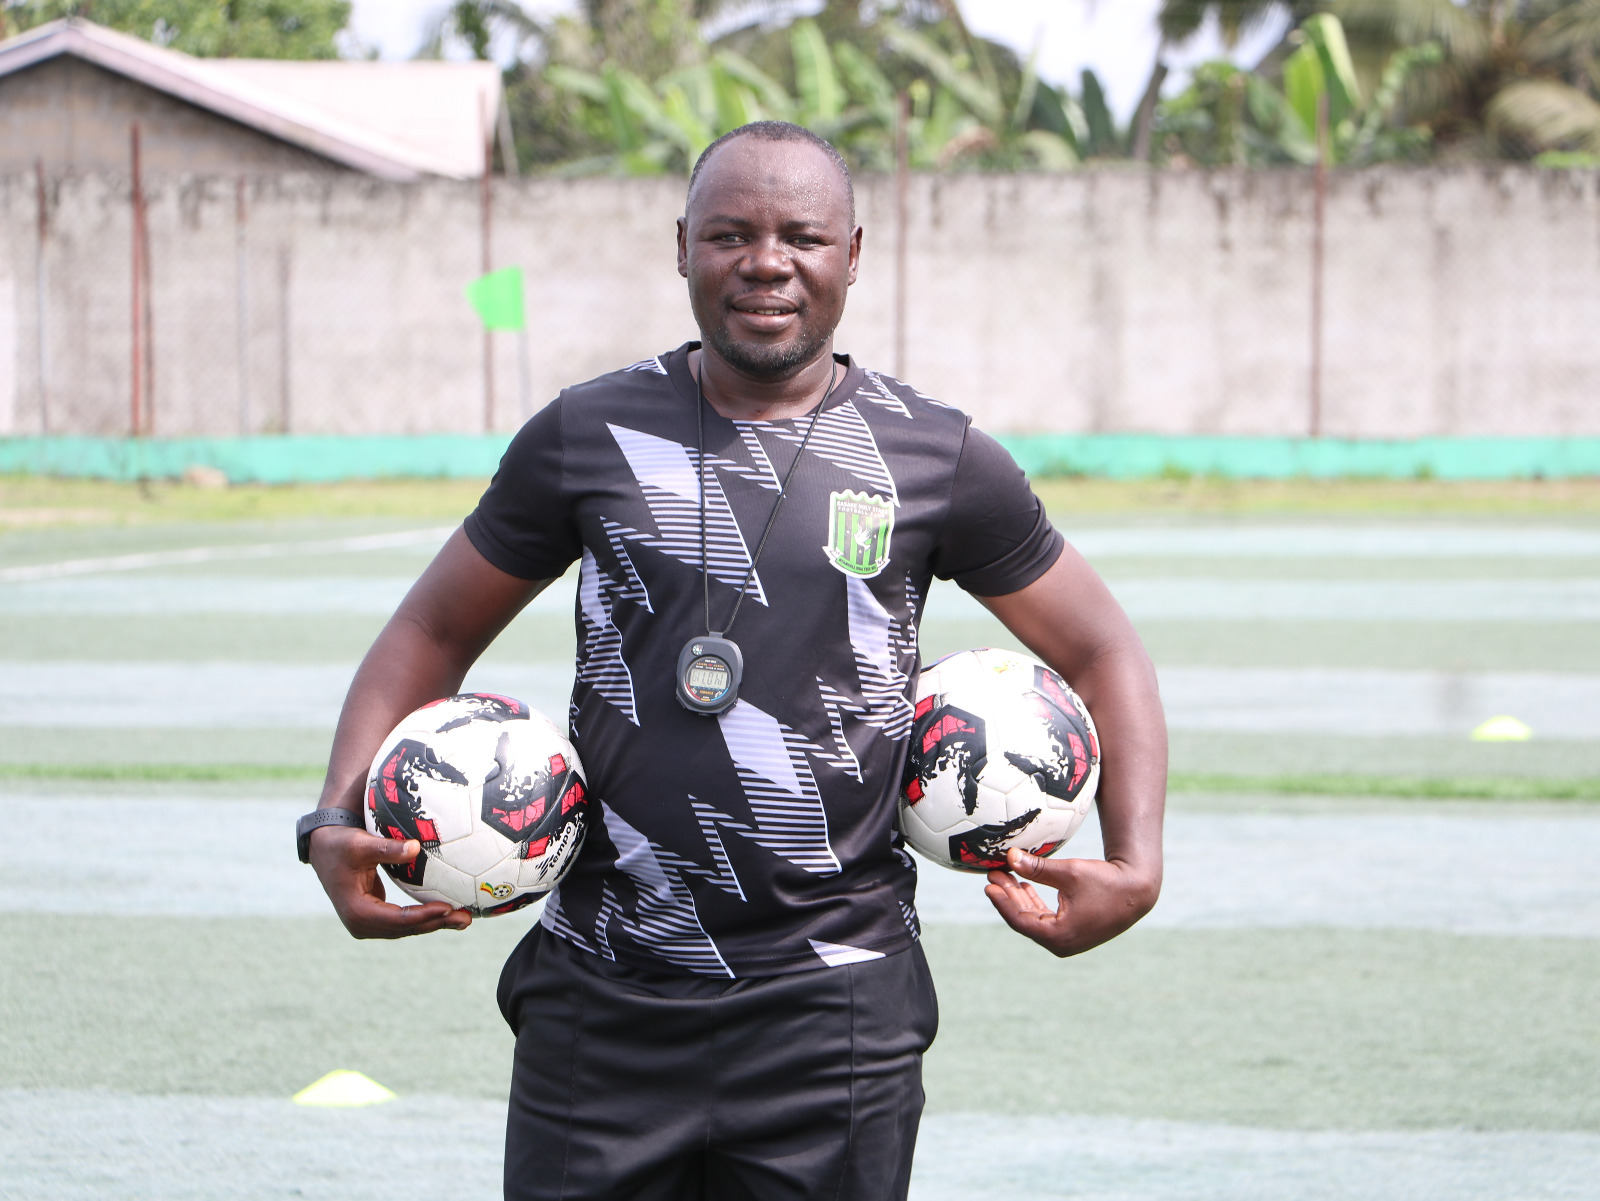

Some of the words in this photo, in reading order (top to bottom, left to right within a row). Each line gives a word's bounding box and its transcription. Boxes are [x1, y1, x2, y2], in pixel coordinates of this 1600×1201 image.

[837, 506, 868, 515] FOOTBALL
[858, 502, 872, 511] HOLY
[549, 826, 572, 868] tempo
